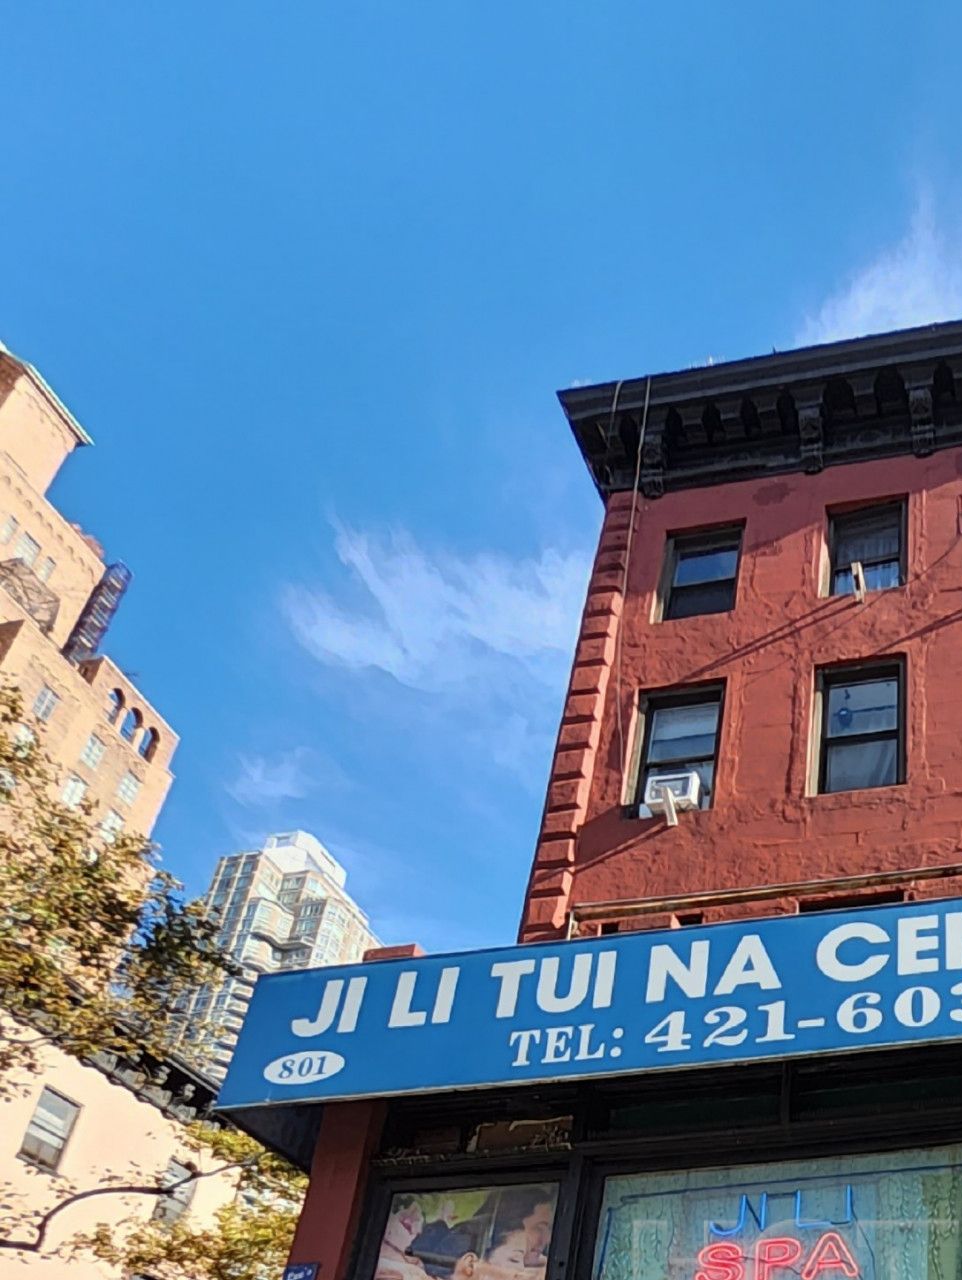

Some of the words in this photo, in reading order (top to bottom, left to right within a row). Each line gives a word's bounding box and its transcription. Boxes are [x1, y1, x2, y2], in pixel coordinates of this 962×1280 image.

[291, 976, 367, 1038] JI
[387, 967, 459, 1029] LI
[490, 950, 616, 1018] TUI
[645, 934, 782, 1004] NA
[509, 1023, 623, 1067] TEL:
[277, 1056, 328, 1079] 801
